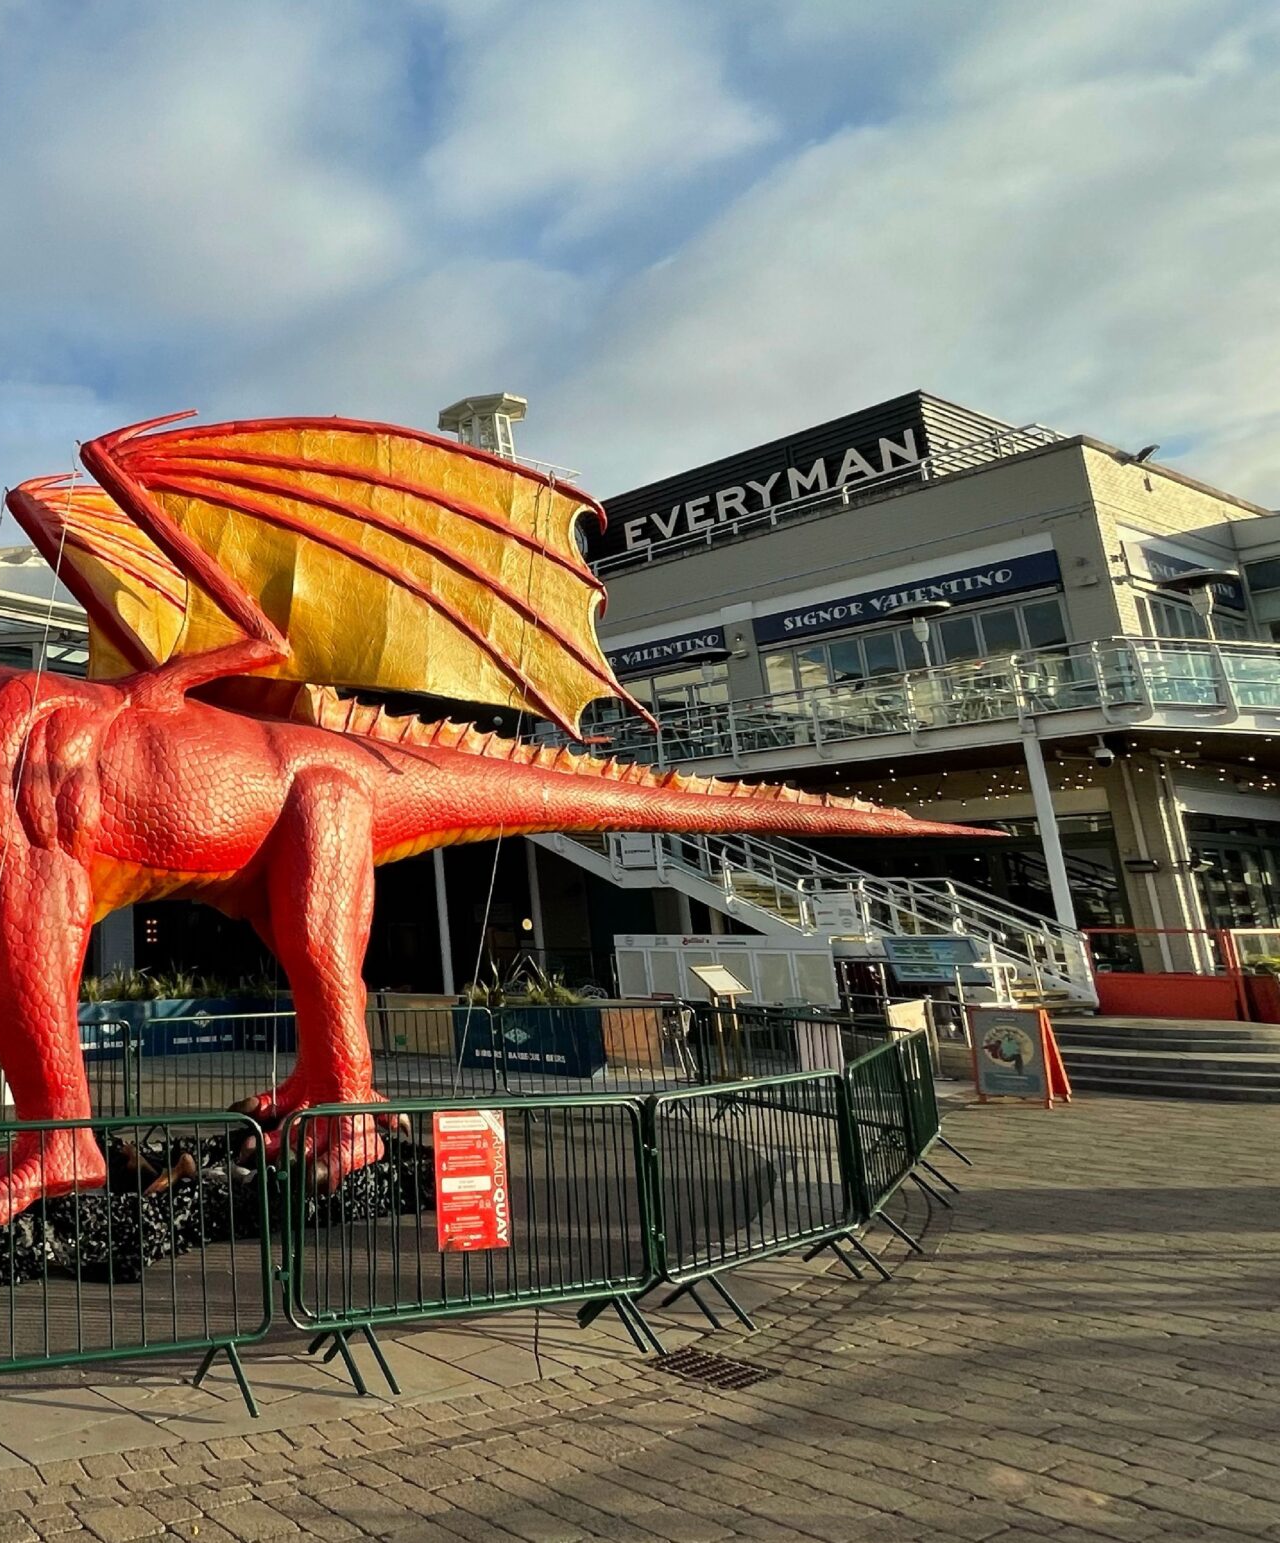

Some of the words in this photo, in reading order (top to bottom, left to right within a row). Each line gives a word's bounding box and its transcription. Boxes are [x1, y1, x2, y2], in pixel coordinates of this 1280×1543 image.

[624, 429, 918, 550] EVERYMAN
[784, 602, 864, 632] SIGNOR
[869, 568, 1013, 612] VALENTINO
[621, 634, 719, 666] VALENTINO
